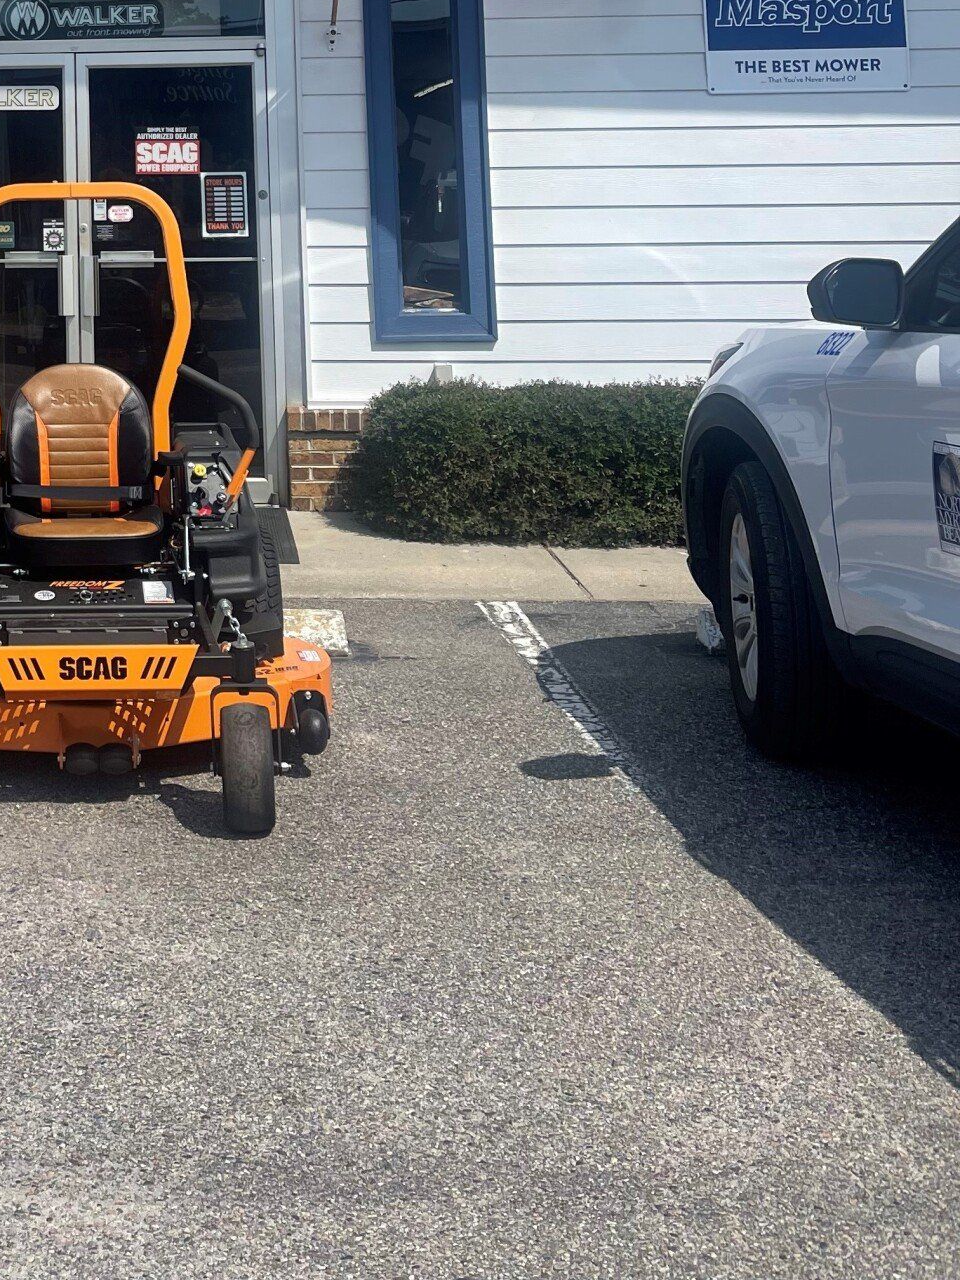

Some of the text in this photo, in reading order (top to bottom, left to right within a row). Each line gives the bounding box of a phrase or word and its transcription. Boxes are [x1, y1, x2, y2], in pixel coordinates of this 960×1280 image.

[51, 4, 160, 27] WALKER
[735, 58, 881, 74] THE BEST MOWER
[136, 132, 198, 140] AUTHORIZED DEALER
[136, 142, 198, 164] SCAG
[137, 164, 199, 172] POWER EQUIPMENT
[207, 222, 245, 230] THANK YOU
[59, 656, 128, 680] SCAG
